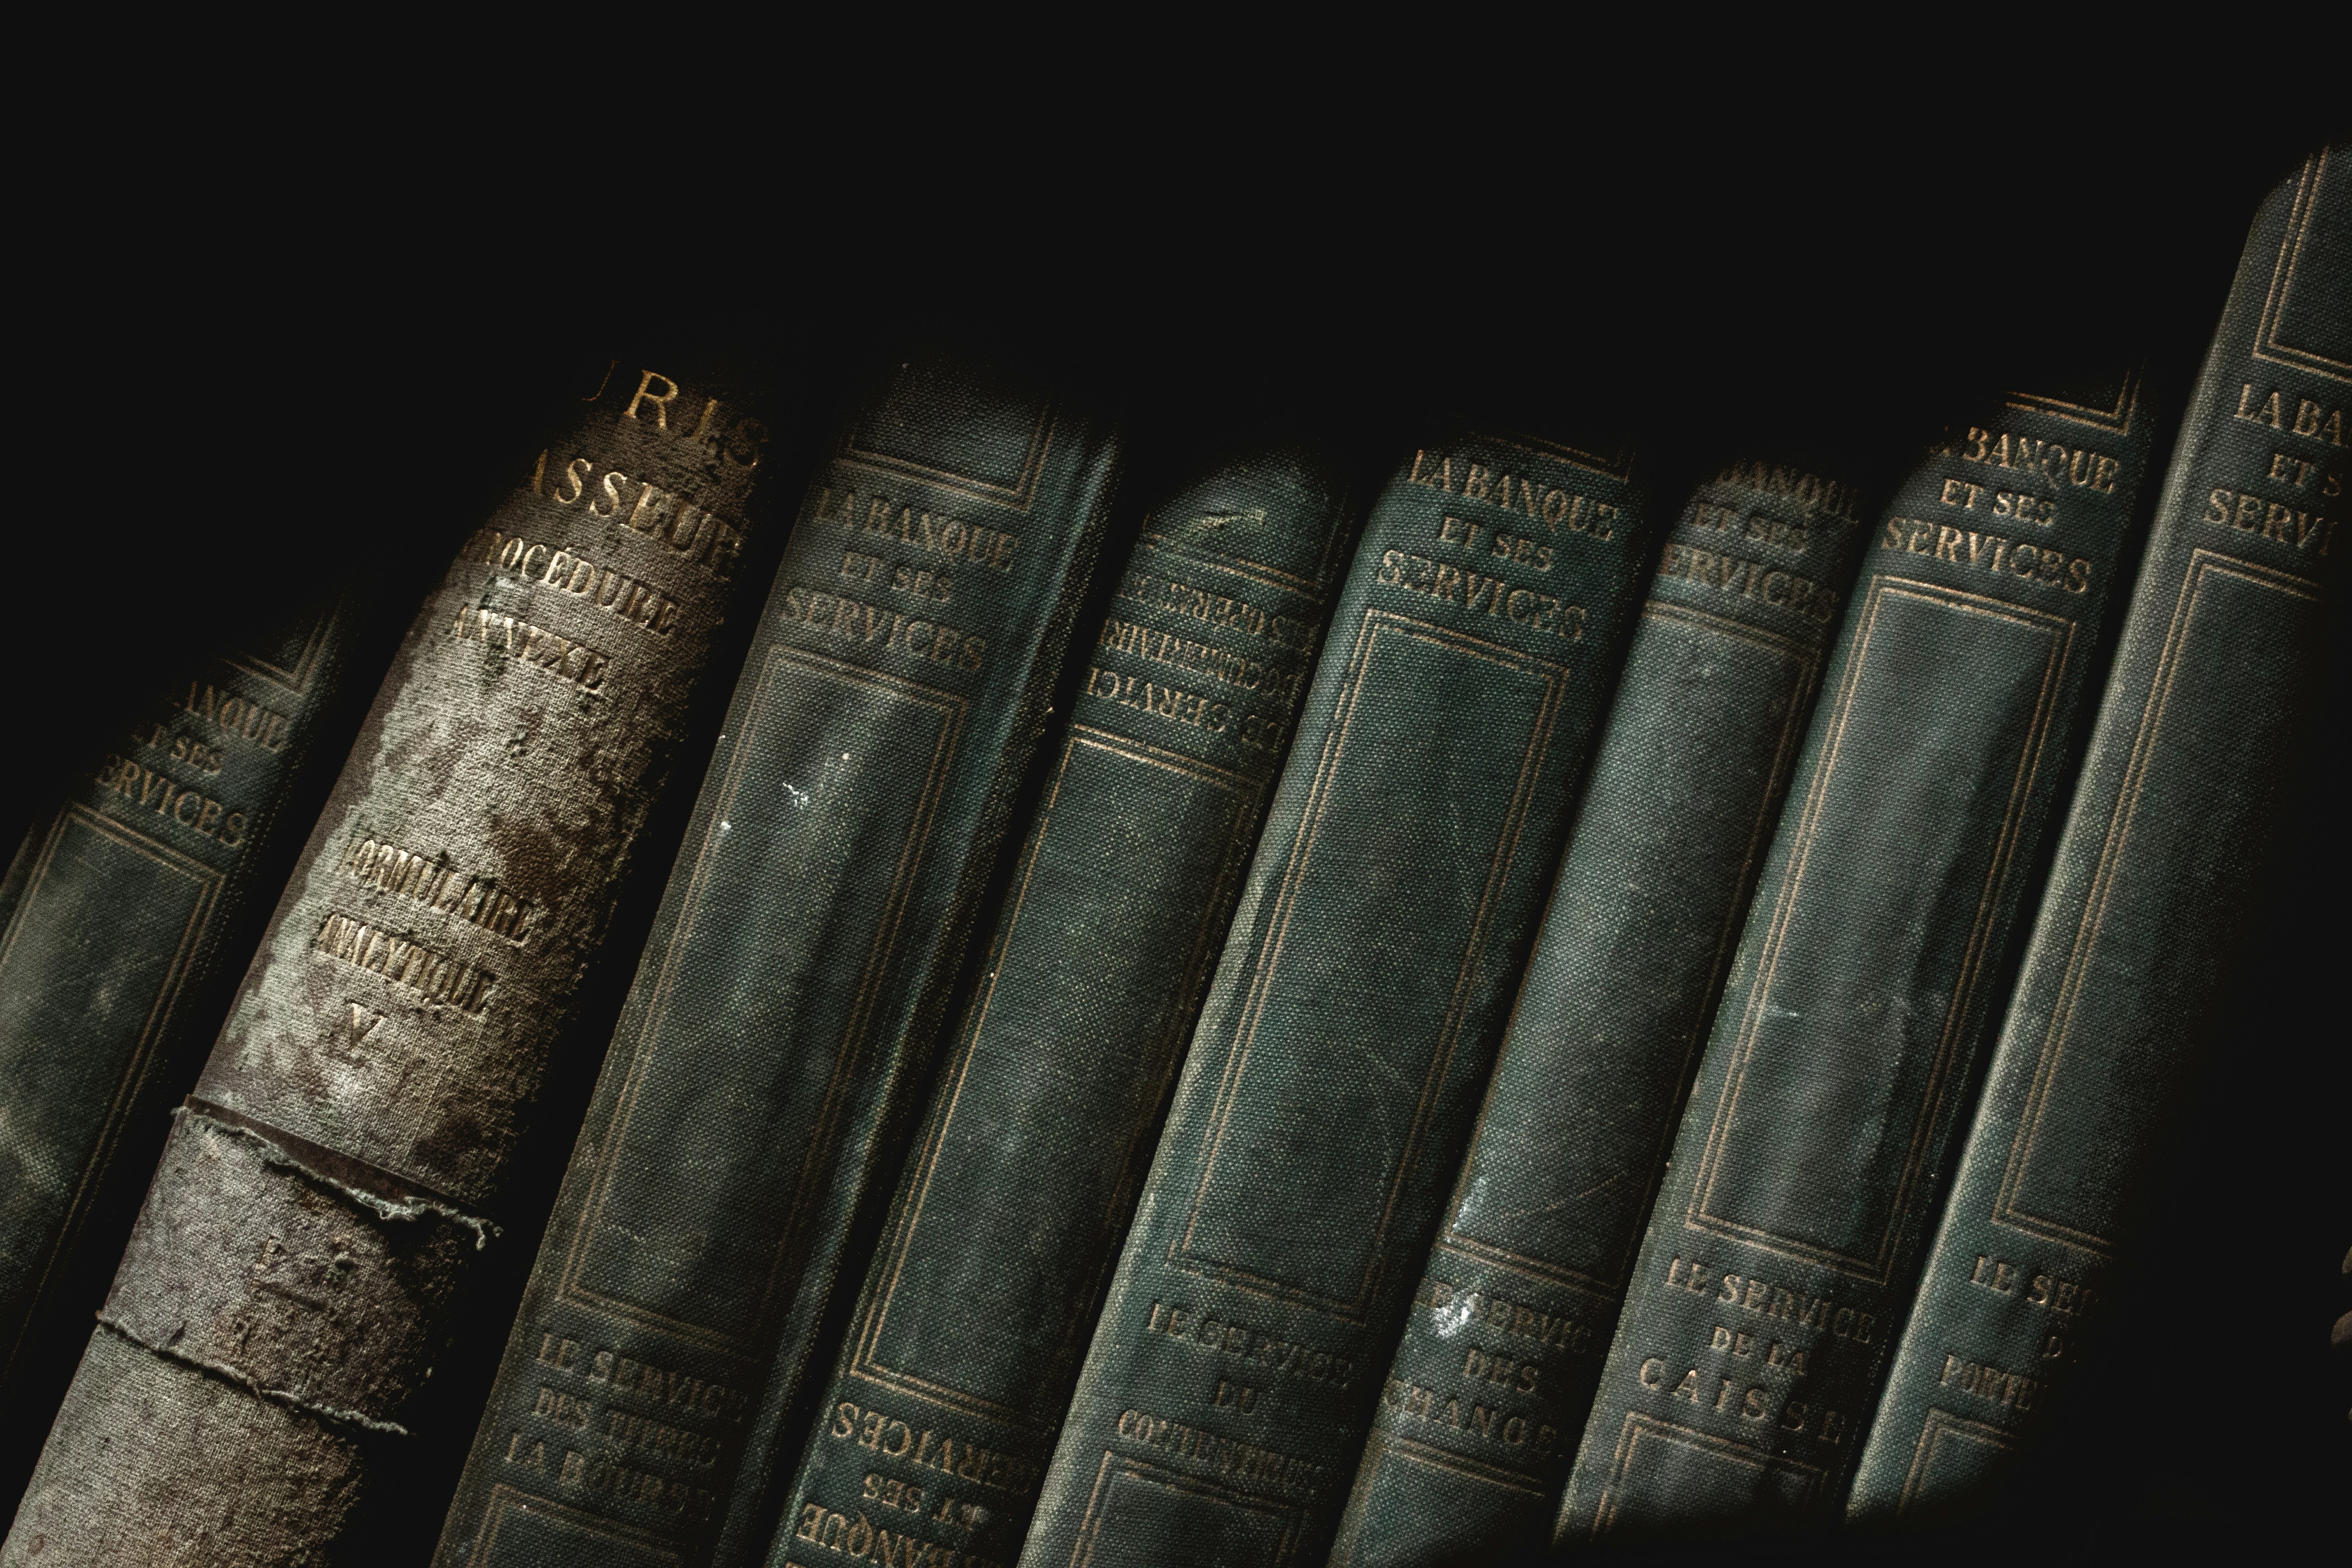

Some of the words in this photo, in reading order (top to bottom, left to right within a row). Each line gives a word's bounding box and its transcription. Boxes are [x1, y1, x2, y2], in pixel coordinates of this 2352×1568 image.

[2233, 383, 2282, 429] LA
[2292, 398, 2352, 448] BA
[1962, 426, 2120, 494] BANQUE
[2267, 453, 2315, 487] ET
[1407, 449, 1452, 492] LA
[1461, 463, 1619, 542] BANQUE
[1693, 502, 1738, 531] ET
[1940, 478, 1984, 509] ET
[1993, 491, 2056, 527] SES
[863, 495, 1020, 572] BANQUE
[1439, 516, 1483, 548] ET
[1490, 532, 1555, 572] SES
[1881, 516, 2092, 594] SERVICES
[890, 565, 953, 604] SES
[1376, 549, 1587, 641] SERVICES
[780, 586, 986, 672] SERVICES
[169, 735, 224, 778] SES
[1666, 1258, 1710, 1295] LE
[1717, 1274, 1876, 1344] SERVICE
[1969, 1256, 2018, 1296] LE
[536, 1332, 580, 1377] LE
[1462, 1347, 1538, 1393] DES
[1710, 1325, 1751, 1357] DE
[1767, 1342, 1807, 1377] LA
[1639, 1357, 1847, 1445] CAISSE
[862, 1473, 926, 1515] SES
